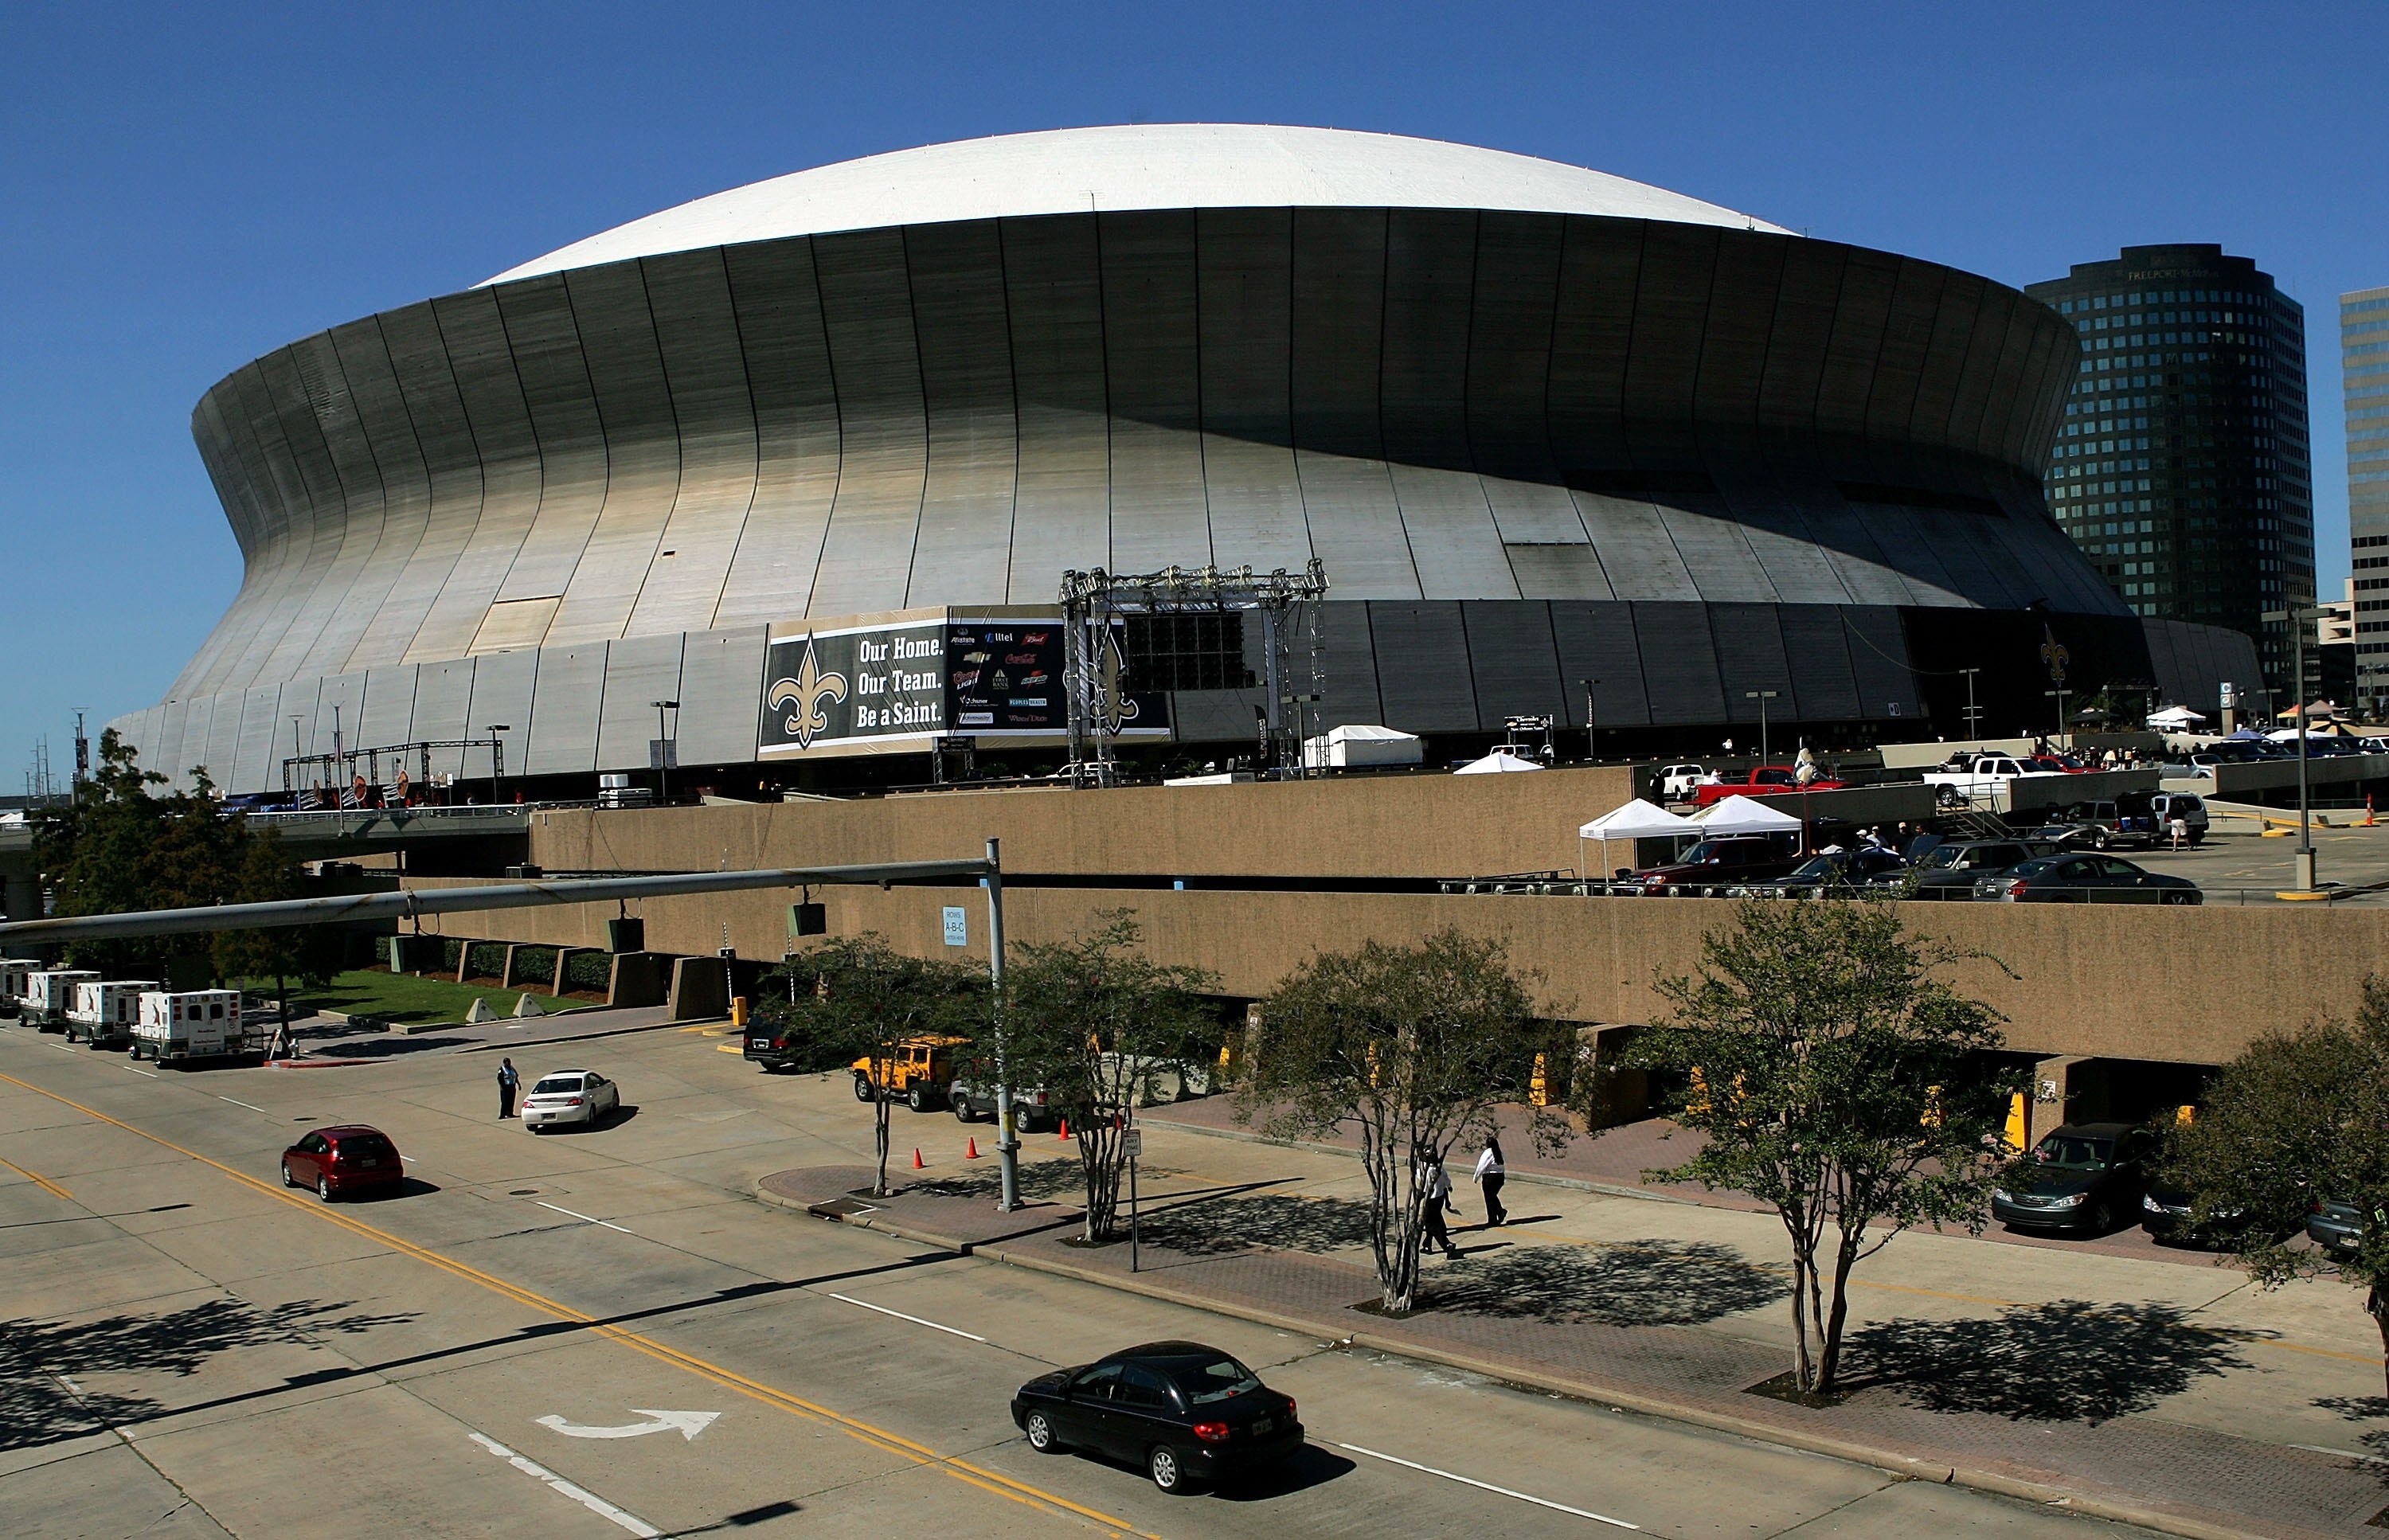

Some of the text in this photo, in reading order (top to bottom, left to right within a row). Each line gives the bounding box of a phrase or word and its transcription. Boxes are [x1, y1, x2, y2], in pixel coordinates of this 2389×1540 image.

[860, 637, 944, 663] Our Home.
[858, 670, 941, 694] Our Team.
[857, 701, 941, 727] Be a Saint.
[945, 921, 964, 932] A-B-C
